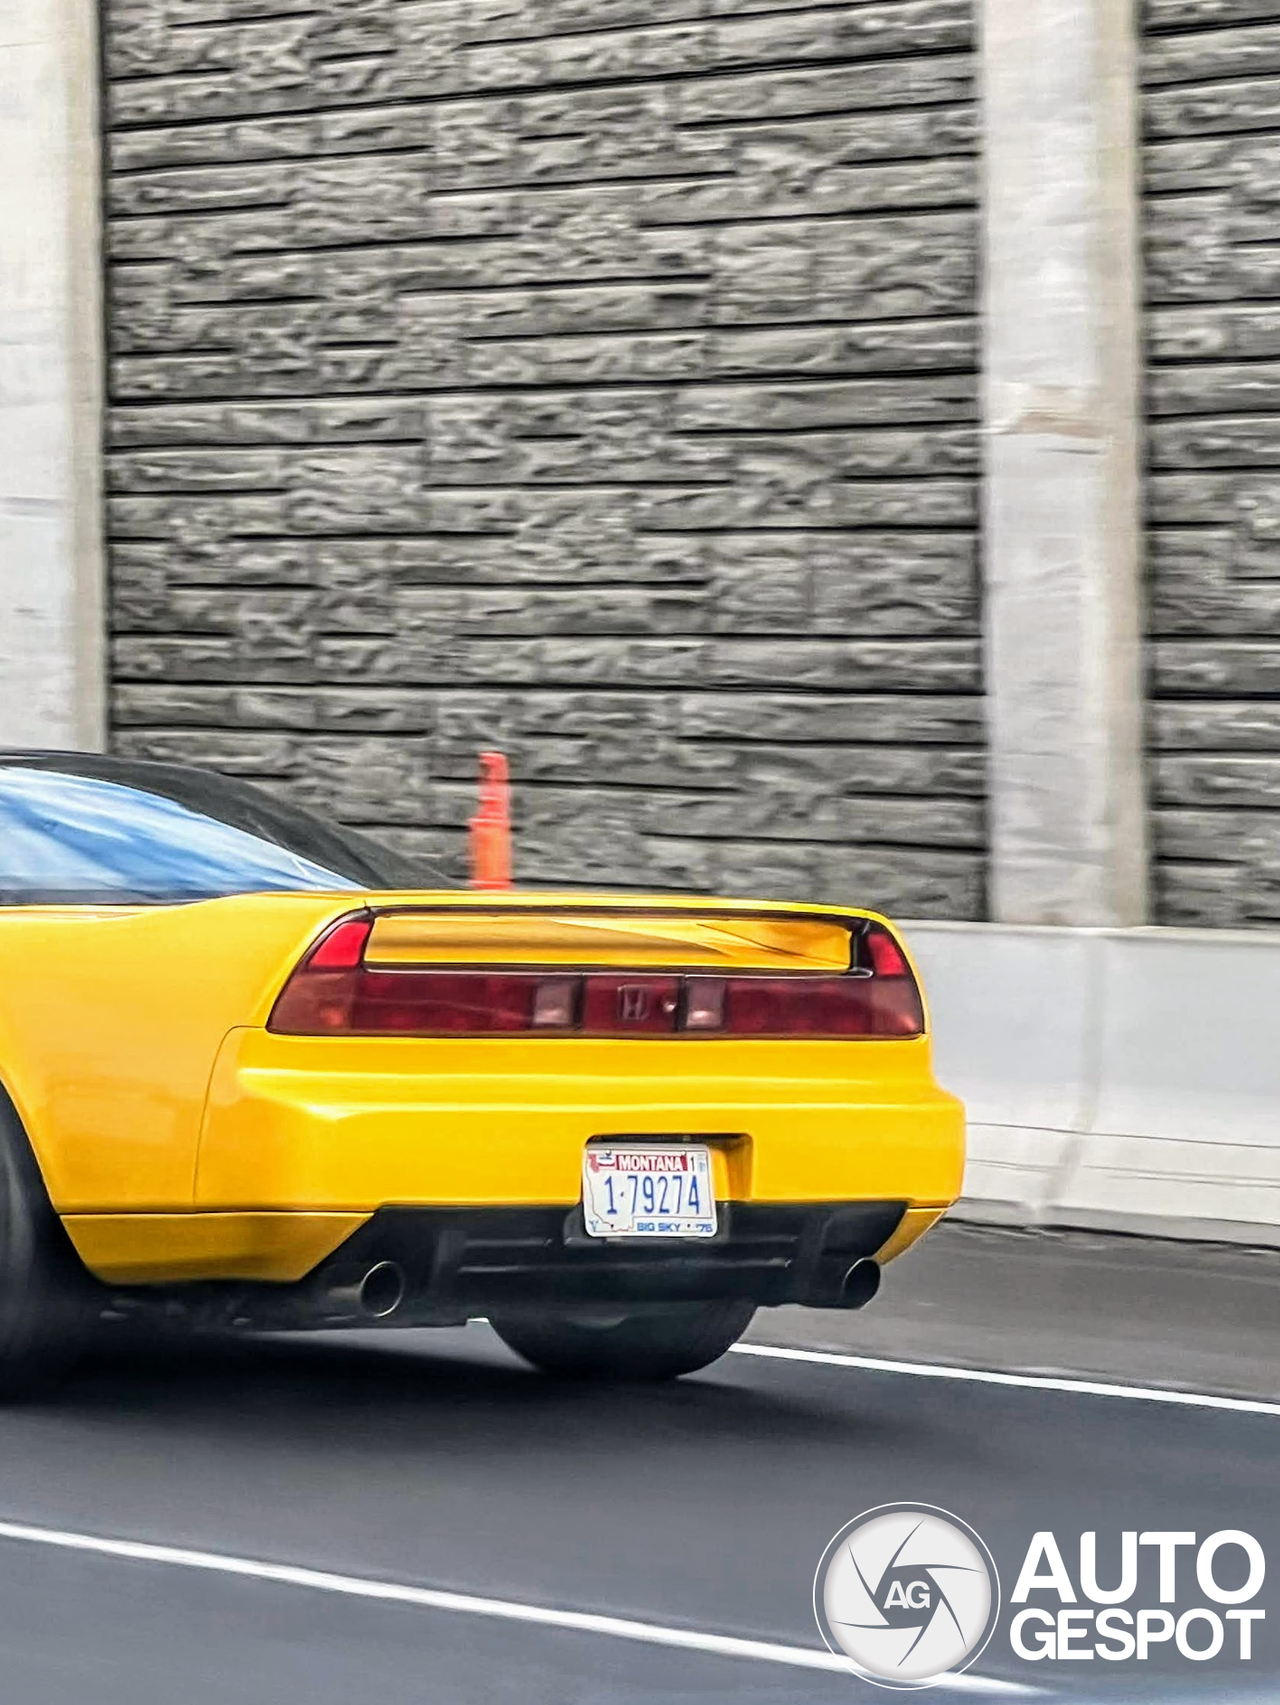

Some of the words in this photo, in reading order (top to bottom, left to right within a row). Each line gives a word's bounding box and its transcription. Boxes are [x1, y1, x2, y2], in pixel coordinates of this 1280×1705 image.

[619, 1155, 683, 1171] MONTANA
[637, 1222, 655, 1232] BIG
[658, 1222, 681, 1232] SKY
